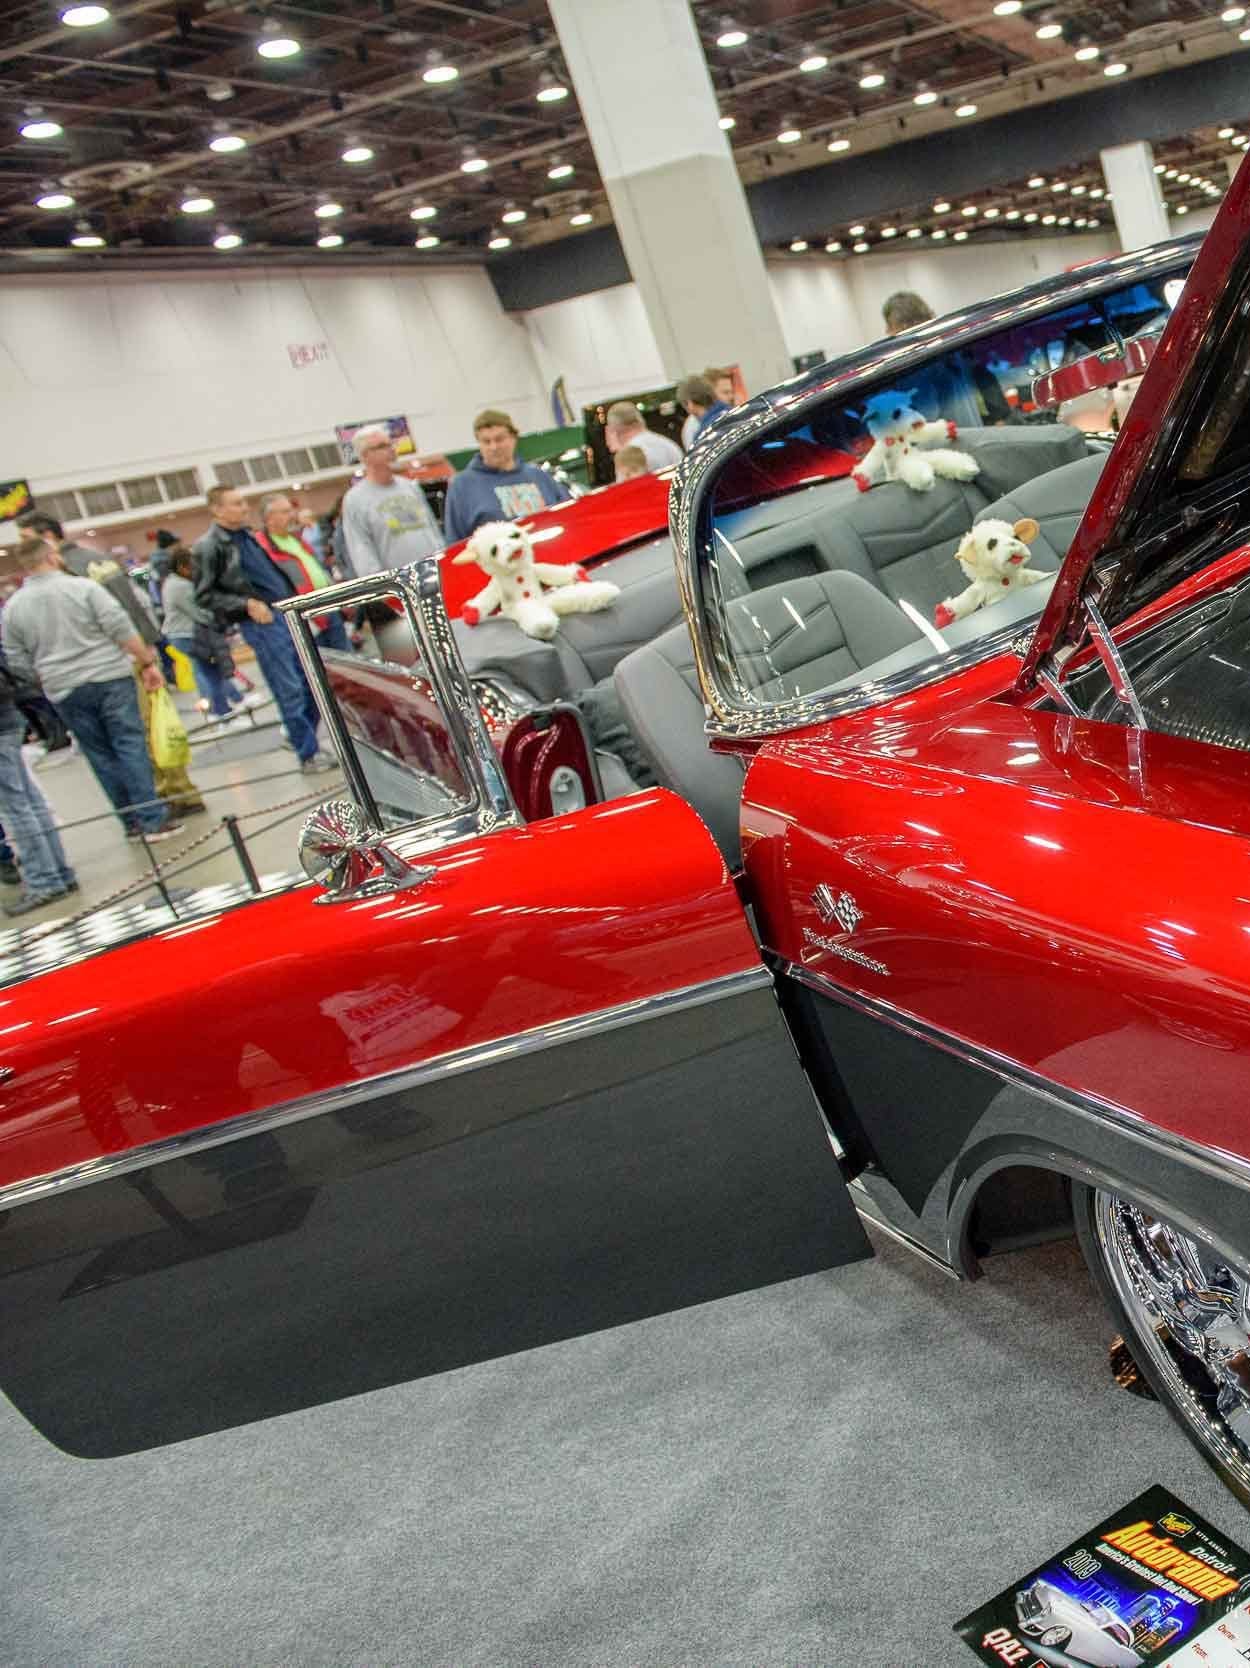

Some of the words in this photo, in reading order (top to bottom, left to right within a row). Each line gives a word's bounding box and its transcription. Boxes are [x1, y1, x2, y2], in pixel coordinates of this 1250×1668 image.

[1062, 1548, 1103, 1580] 2019
[1099, 1519, 1241, 1603] Autorama
[1187, 1546, 1238, 1574] Detroit
[982, 1627, 1031, 1668] QA1
